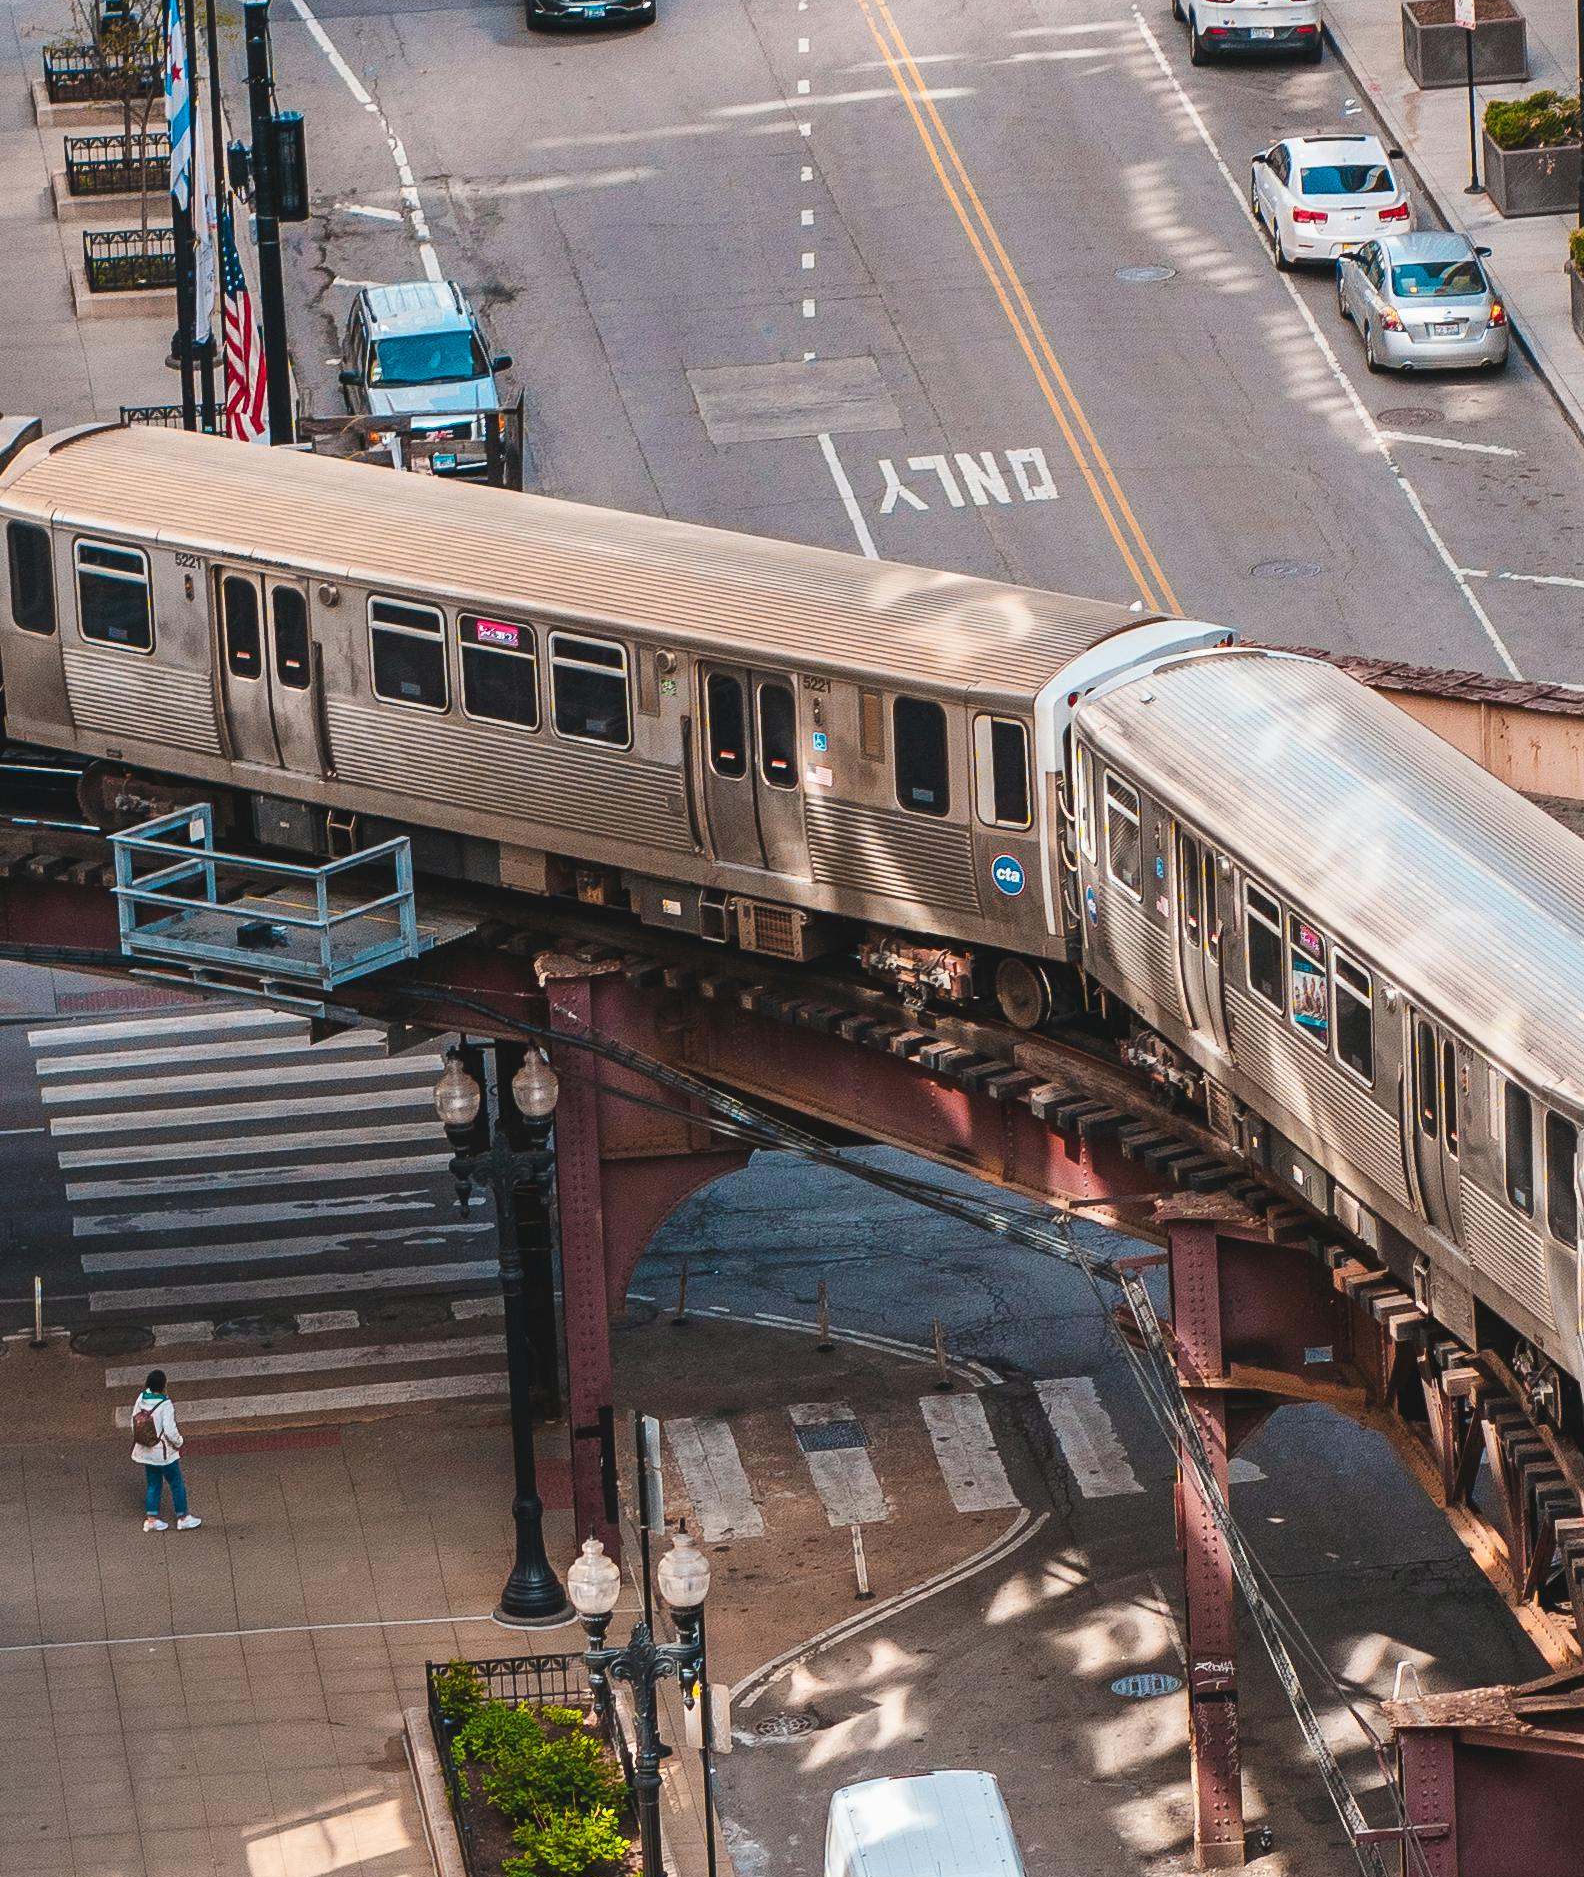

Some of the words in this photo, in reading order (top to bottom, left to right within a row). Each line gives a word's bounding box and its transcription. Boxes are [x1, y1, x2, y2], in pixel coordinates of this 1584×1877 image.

[878, 447, 1060, 514] ONLY
[175, 552, 201, 570] 5221
[803, 675, 832, 694] 5221
[996, 867, 1020, 883] cta
